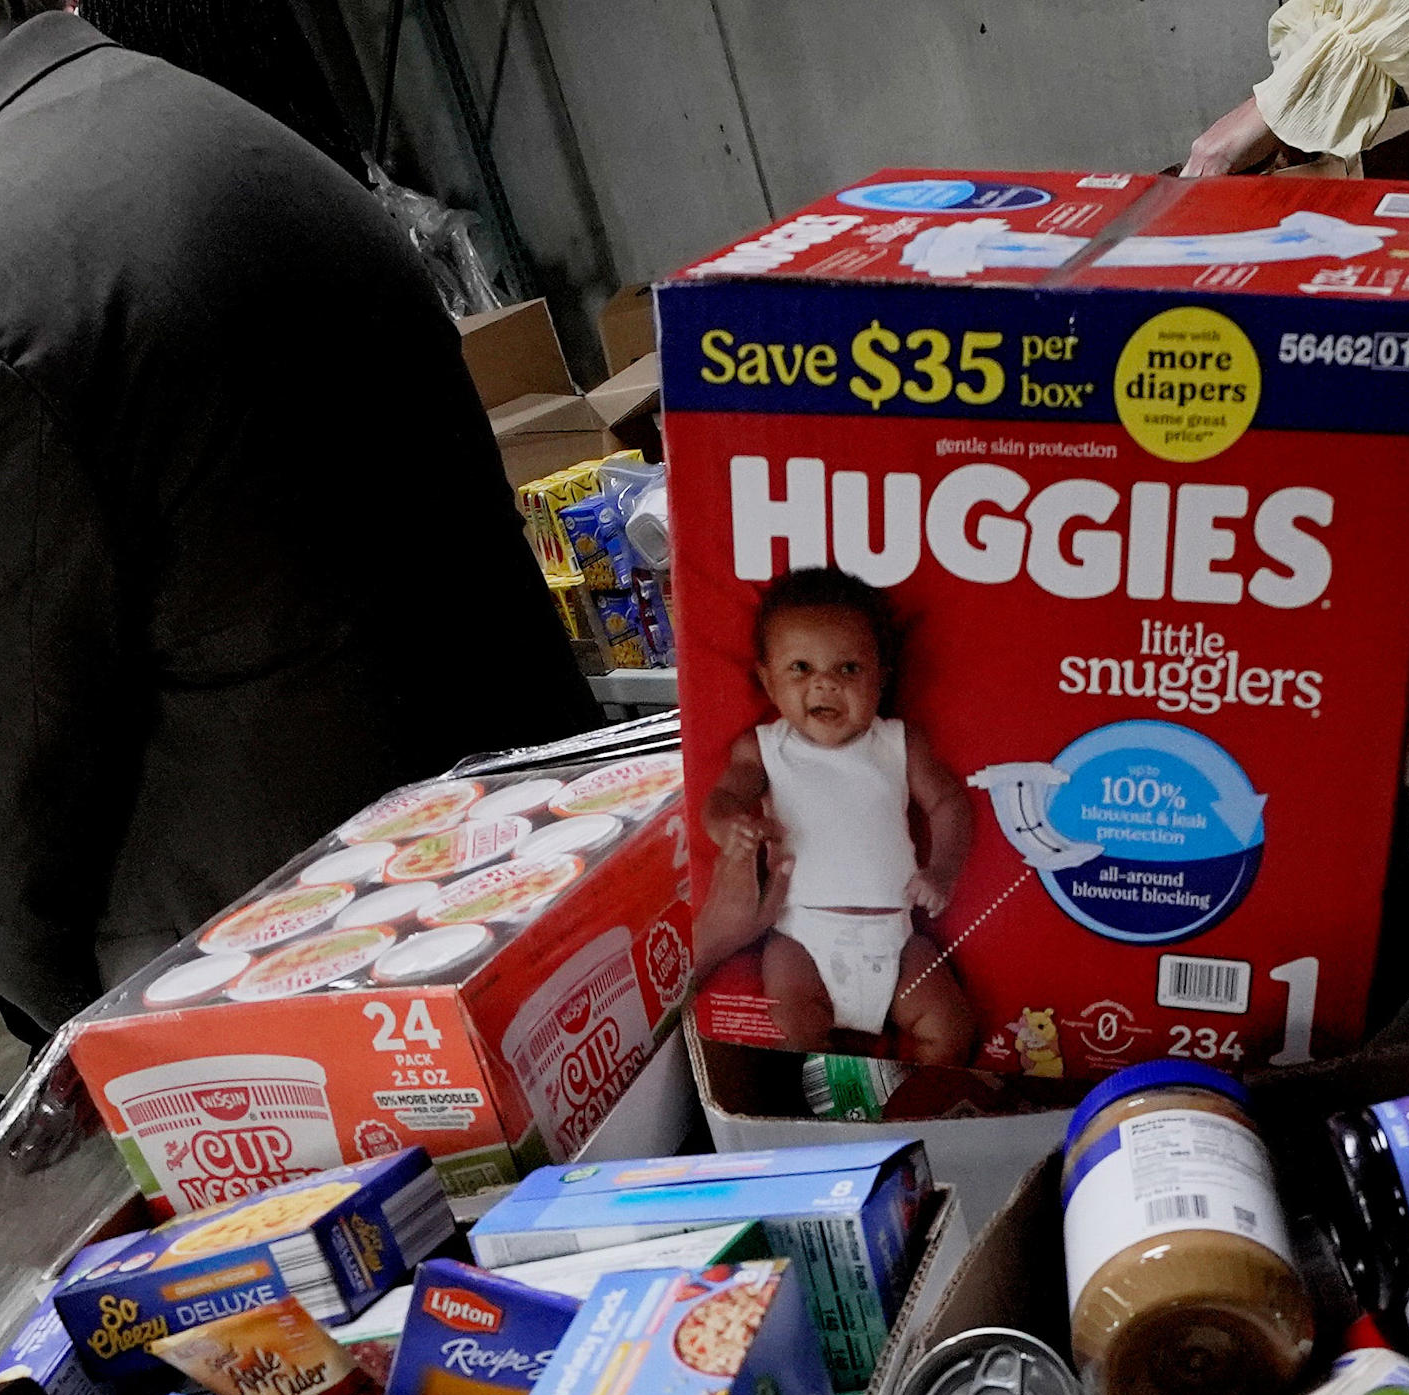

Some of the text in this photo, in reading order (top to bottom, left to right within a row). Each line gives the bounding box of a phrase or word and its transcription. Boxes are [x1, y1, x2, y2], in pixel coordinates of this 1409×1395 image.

[701, 320, 1005, 410] Save $35
[1022, 336, 1077, 367] per
[1148, 349, 1232, 371] more
[1126, 375, 1246, 406] diapers
[936, 437, 1118, 459] gentle skin protection
[731, 456, 1333, 609] HUGGIES
[1141, 618, 1224, 660] little
[1059, 656, 1322, 714] snugglers
[1101, 776, 1186, 810] 100%
[1081, 805, 1207, 829] blowout & leak
[1096, 827, 1186, 845] protection
[1099, 866, 1184, 888] all-around
[1072, 881, 1211, 911] blowout blocking
[652, 934, 669, 962] NEW
[657, 949, 679, 983] LOOK!
[363, 999, 442, 1052] 24
[1269, 957, 1319, 1067] 1
[395, 1053, 434, 1067] PACK
[1167, 1024, 1245, 1062] 234
[391, 1068, 451, 1086] 2.5 OZ
[561, 1016, 621, 1107] CUP
[201, 1091, 247, 1110] NISSIN
[377, 1092, 479, 1107] 10% MORE NOODLES
[191, 1125, 292, 1180] CUP
[99, 1294, 139, 1330] So
[176, 1285, 278, 1327] DELUXE
[431, 1290, 495, 1328] Lipton
[87, 1315, 169, 1359] Cheezy
[441, 1337, 538, 1379] Recipe
